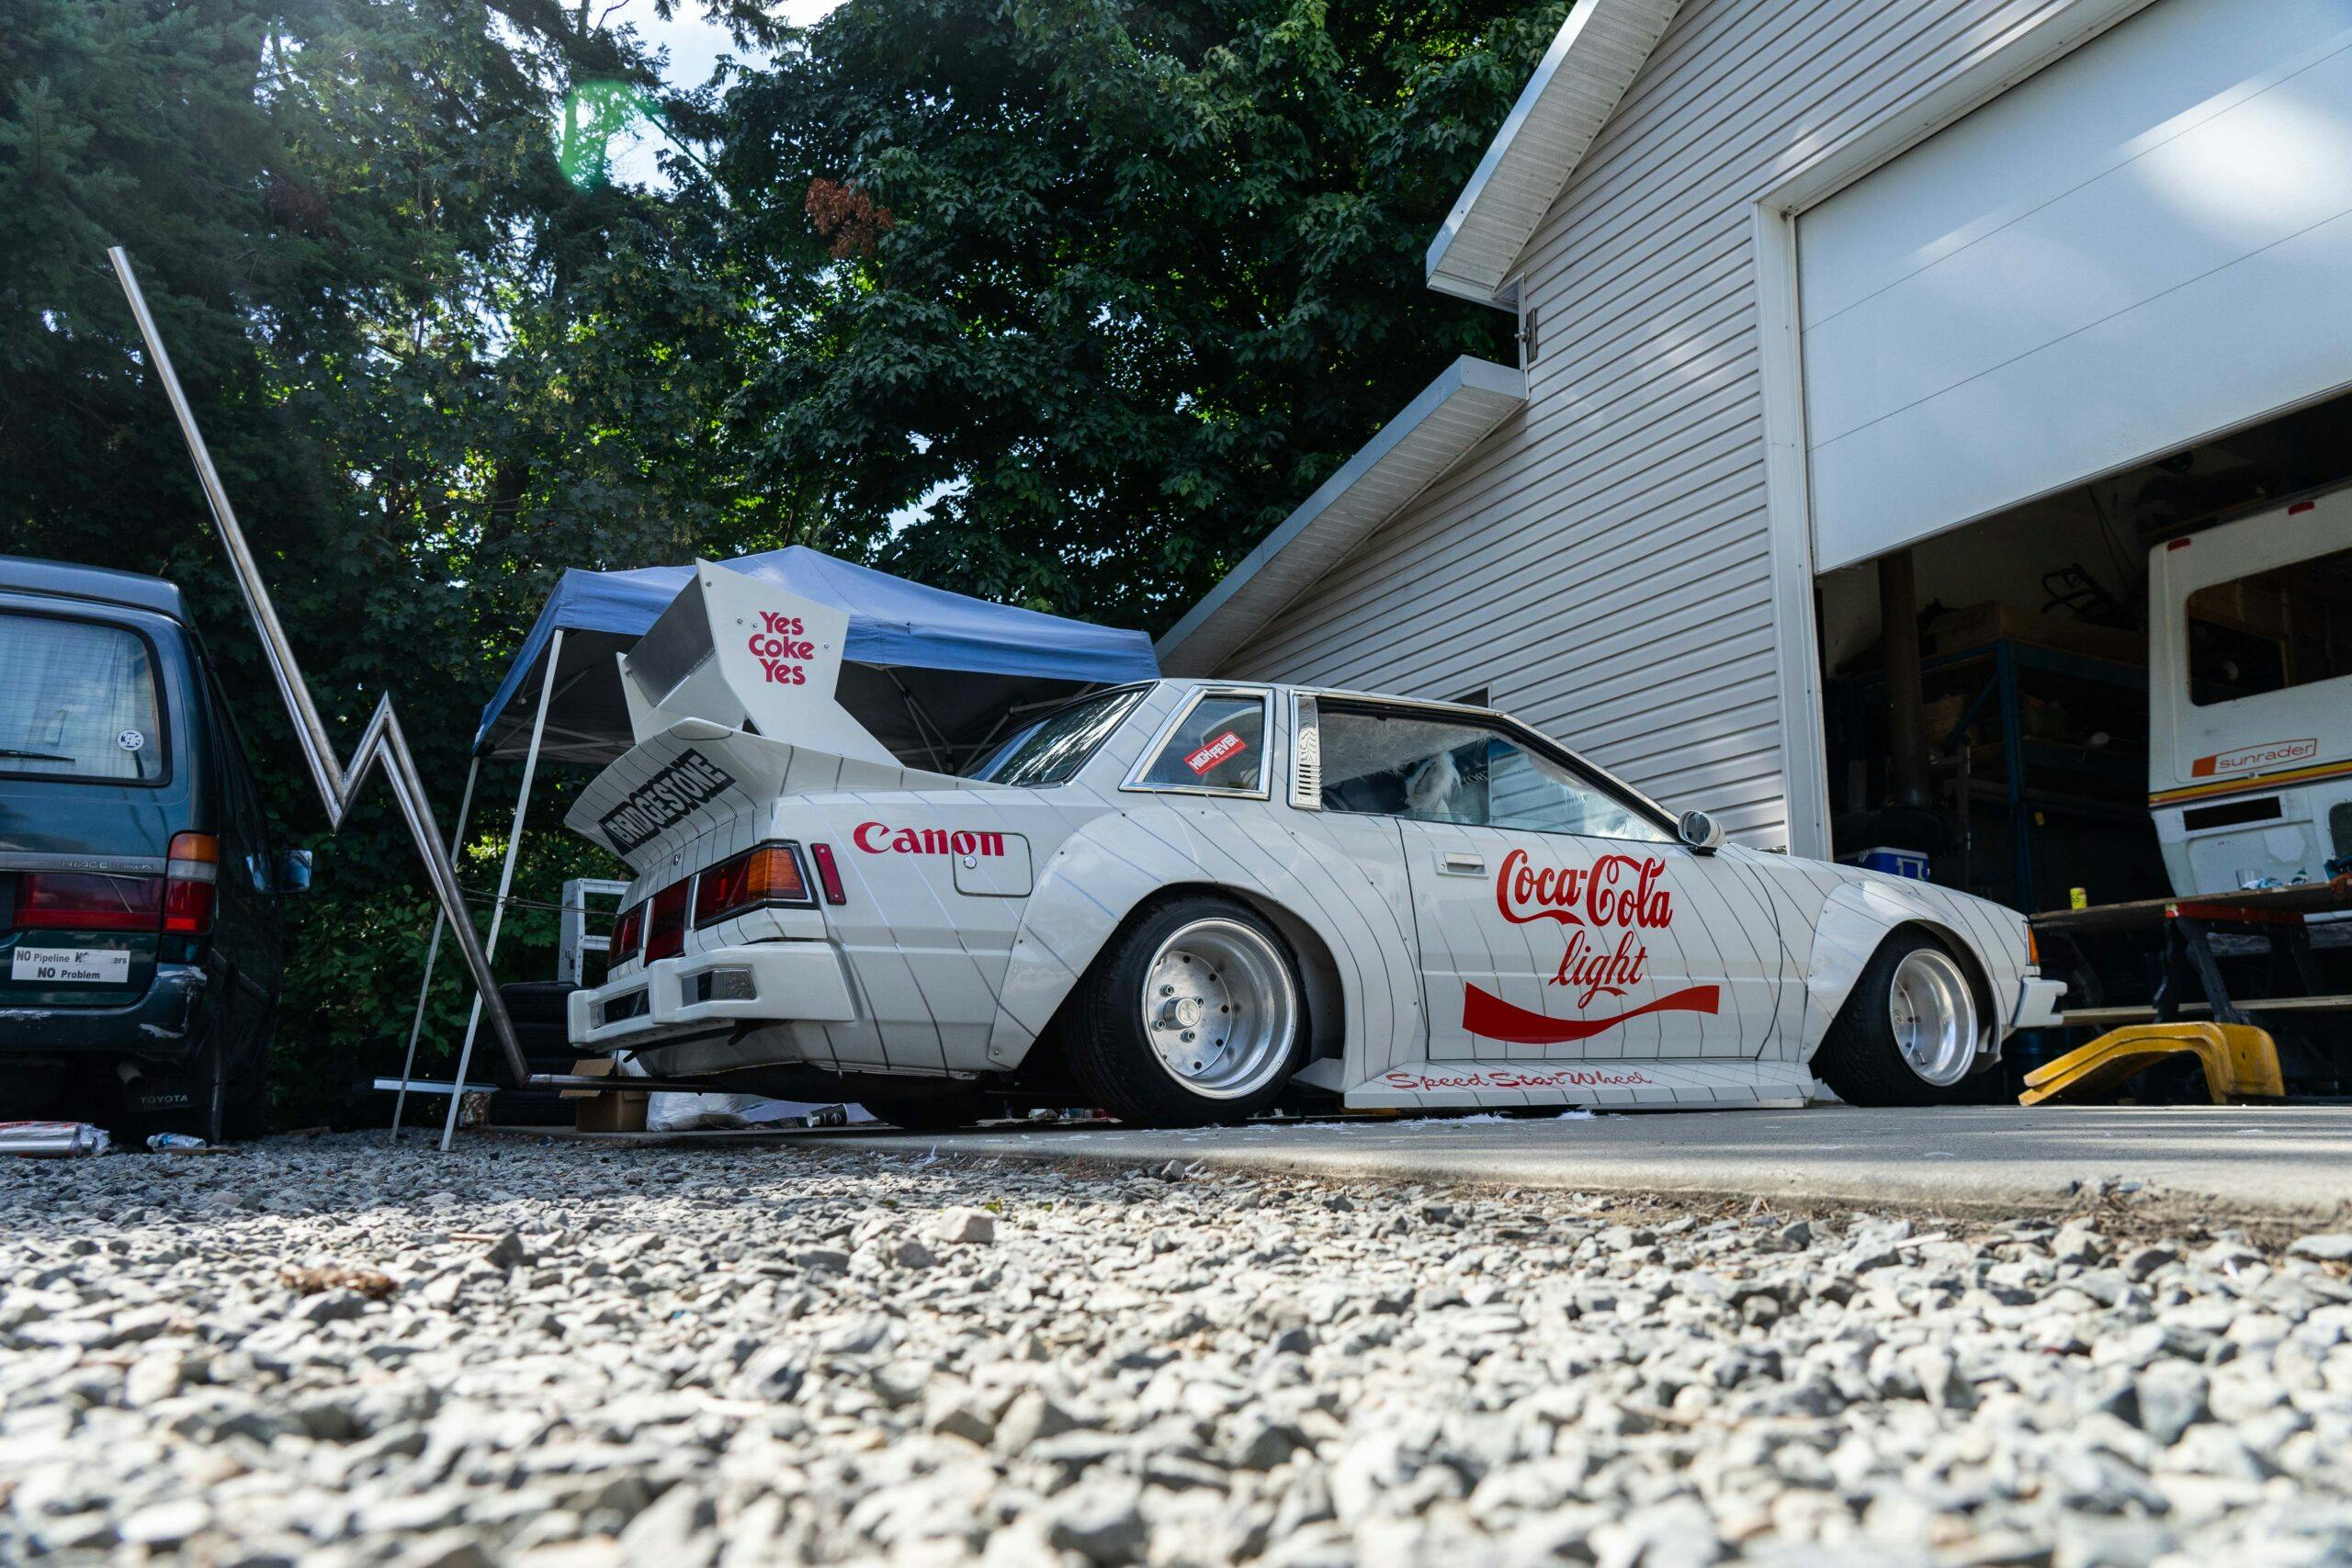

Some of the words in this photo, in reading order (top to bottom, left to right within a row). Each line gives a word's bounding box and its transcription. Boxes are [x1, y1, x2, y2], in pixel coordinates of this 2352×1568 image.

[759, 611, 804, 636] Yes
[748, 633, 815, 660] Coke
[758, 658, 806, 685] Yes
[1189, 749, 1213, 770] HIGH
[1208, 734, 1239, 759] FEVER
[2219, 744, 2313, 769] sunrader
[604, 753, 729, 844] BRIDGESTONE
[853, 821, 1005, 856] Canon
[1496, 848, 1674, 929] Coca-Cola
[16, 951, 31, 962] NO
[33, 953, 71, 964] Pipeline
[1547, 930, 1648, 1010] light
[38, 966, 56, 978] NO
[61, 969, 101, 979] Problem
[1385, 1072, 1489, 1091] Speed
[1488, 1072, 1562, 1088] Star
[1555, 1070, 1653, 1086] Wheel
[140, 1094, 188, 1104] TOYOTA
